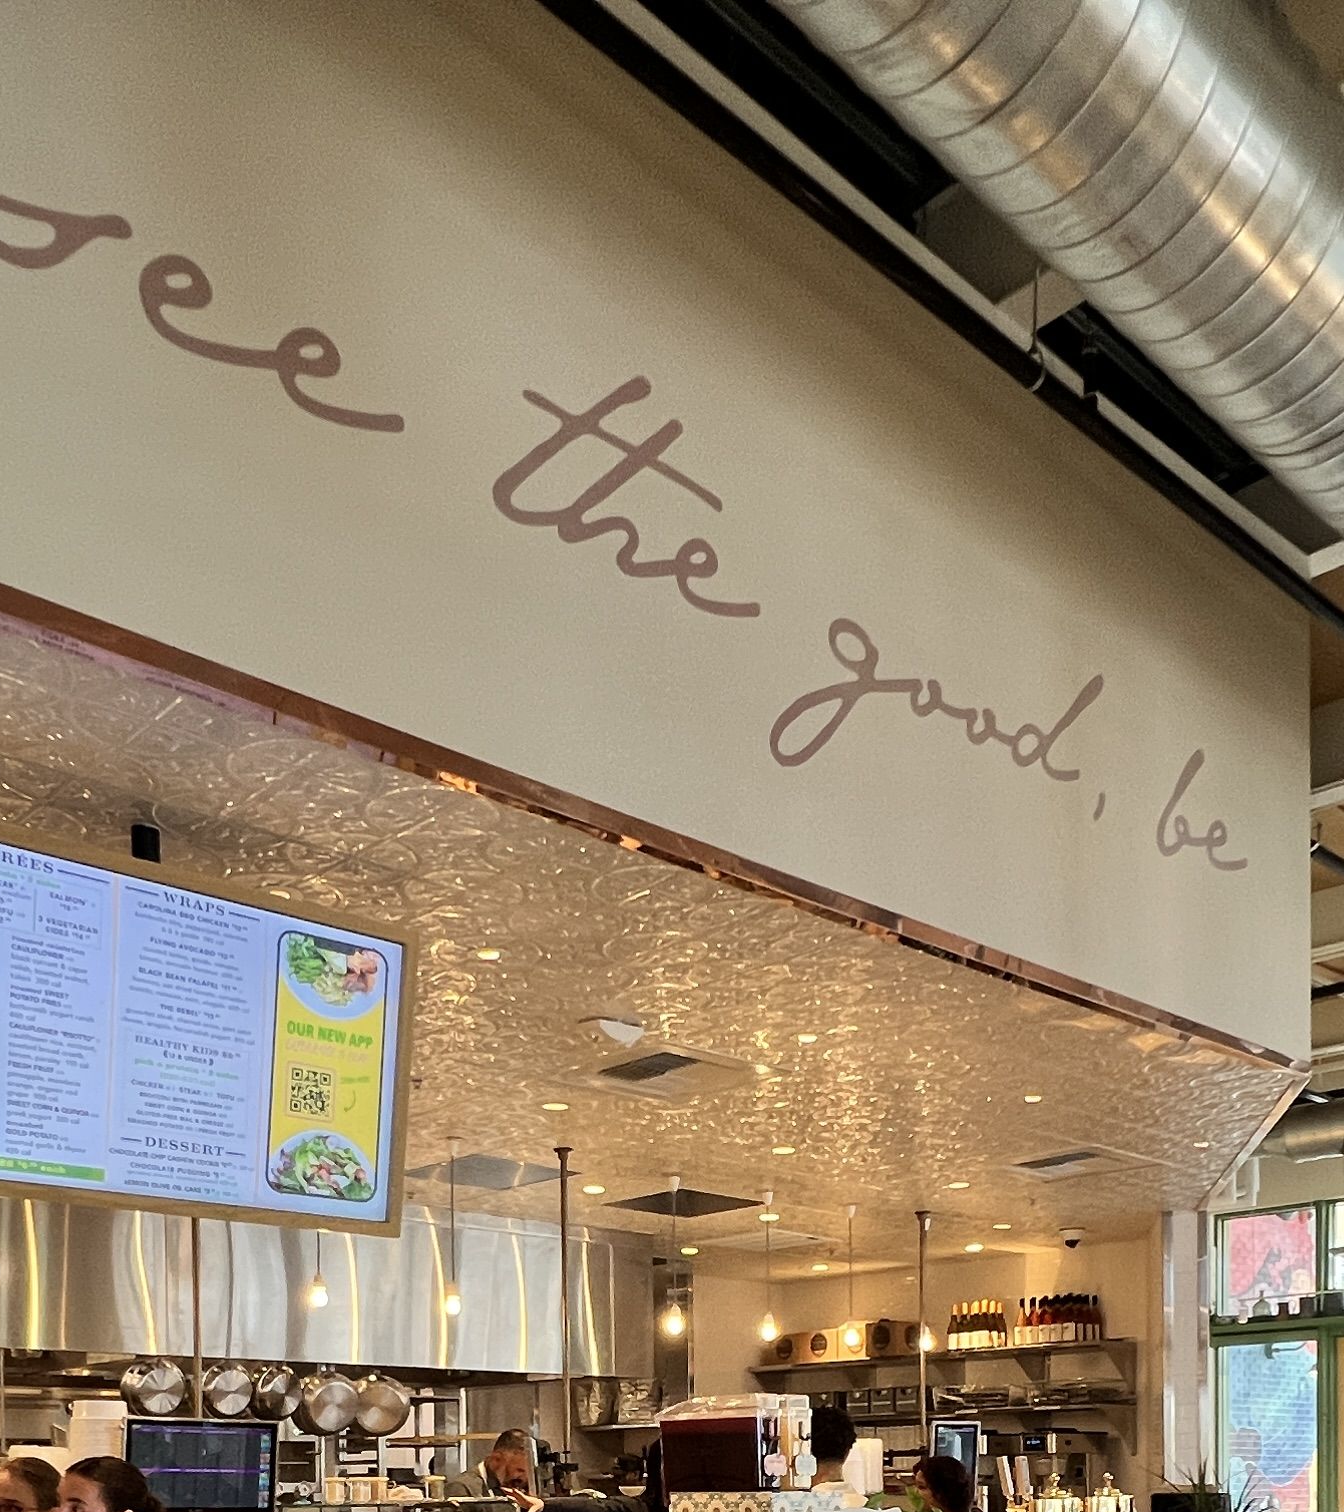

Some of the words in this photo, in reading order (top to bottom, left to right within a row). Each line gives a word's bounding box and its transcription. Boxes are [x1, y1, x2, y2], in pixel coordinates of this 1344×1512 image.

[493, 374, 761, 618] the
[769, 617, 1106, 822] good,
[1156, 749, 1248, 872] be
[163, 891, 225, 917] WRAPS
[286, 1019, 314, 1039] OUR
[317, 1026, 346, 1045] NEW
[349, 1032, 372, 1050] APP
[144, 1135, 224, 1157] DESSERT
